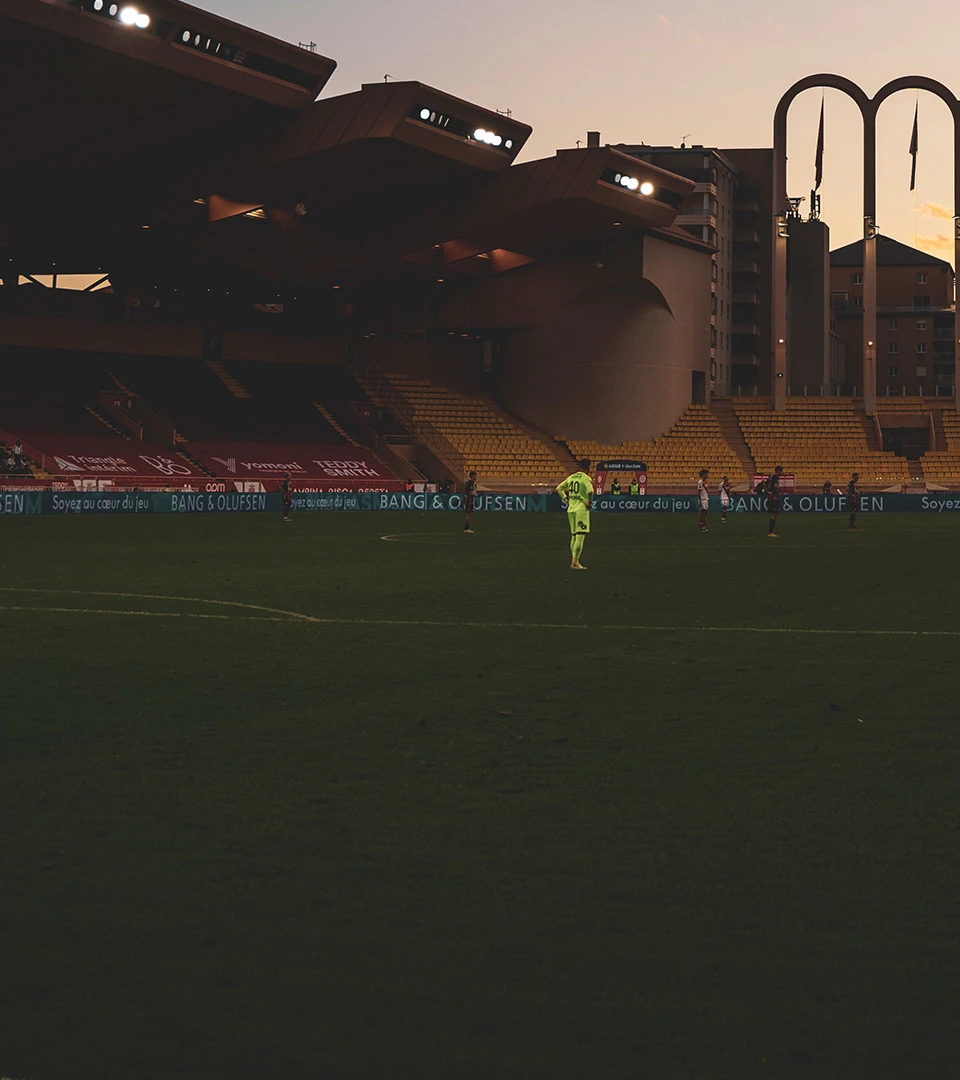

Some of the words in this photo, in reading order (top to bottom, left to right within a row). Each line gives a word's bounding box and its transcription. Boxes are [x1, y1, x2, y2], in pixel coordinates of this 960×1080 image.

[67, 455, 128, 465] Triangle
[312, 460, 368, 469] TEDDY
[83, 464, 137, 473] intérim
[323, 468, 380, 477] SMITH
[569, 480, 580, 494] 40
[52, 494, 81, 513] Soyez
[83, 500, 95, 510] au
[122, 496, 134, 510] du
[135, 496, 149, 513] jeu
[171, 495, 204, 511] BANG
[208, 495, 215, 510] &
[217, 495, 266, 510] OLUFSEN
[306, 499, 316, 508] au
[334, 495, 343, 508] du
[343, 495, 356, 510] jeu
[380, 494, 425, 509] BANG
[432, 495, 443, 509] &
[601, 499, 614, 509] au
[653, 497, 668, 509] du
[671, 497, 690, 512] jeu
[782, 497, 794, 511] &
[799, 496, 884, 512] OLUFEN
[921, 497, 960, 512] Soyez
